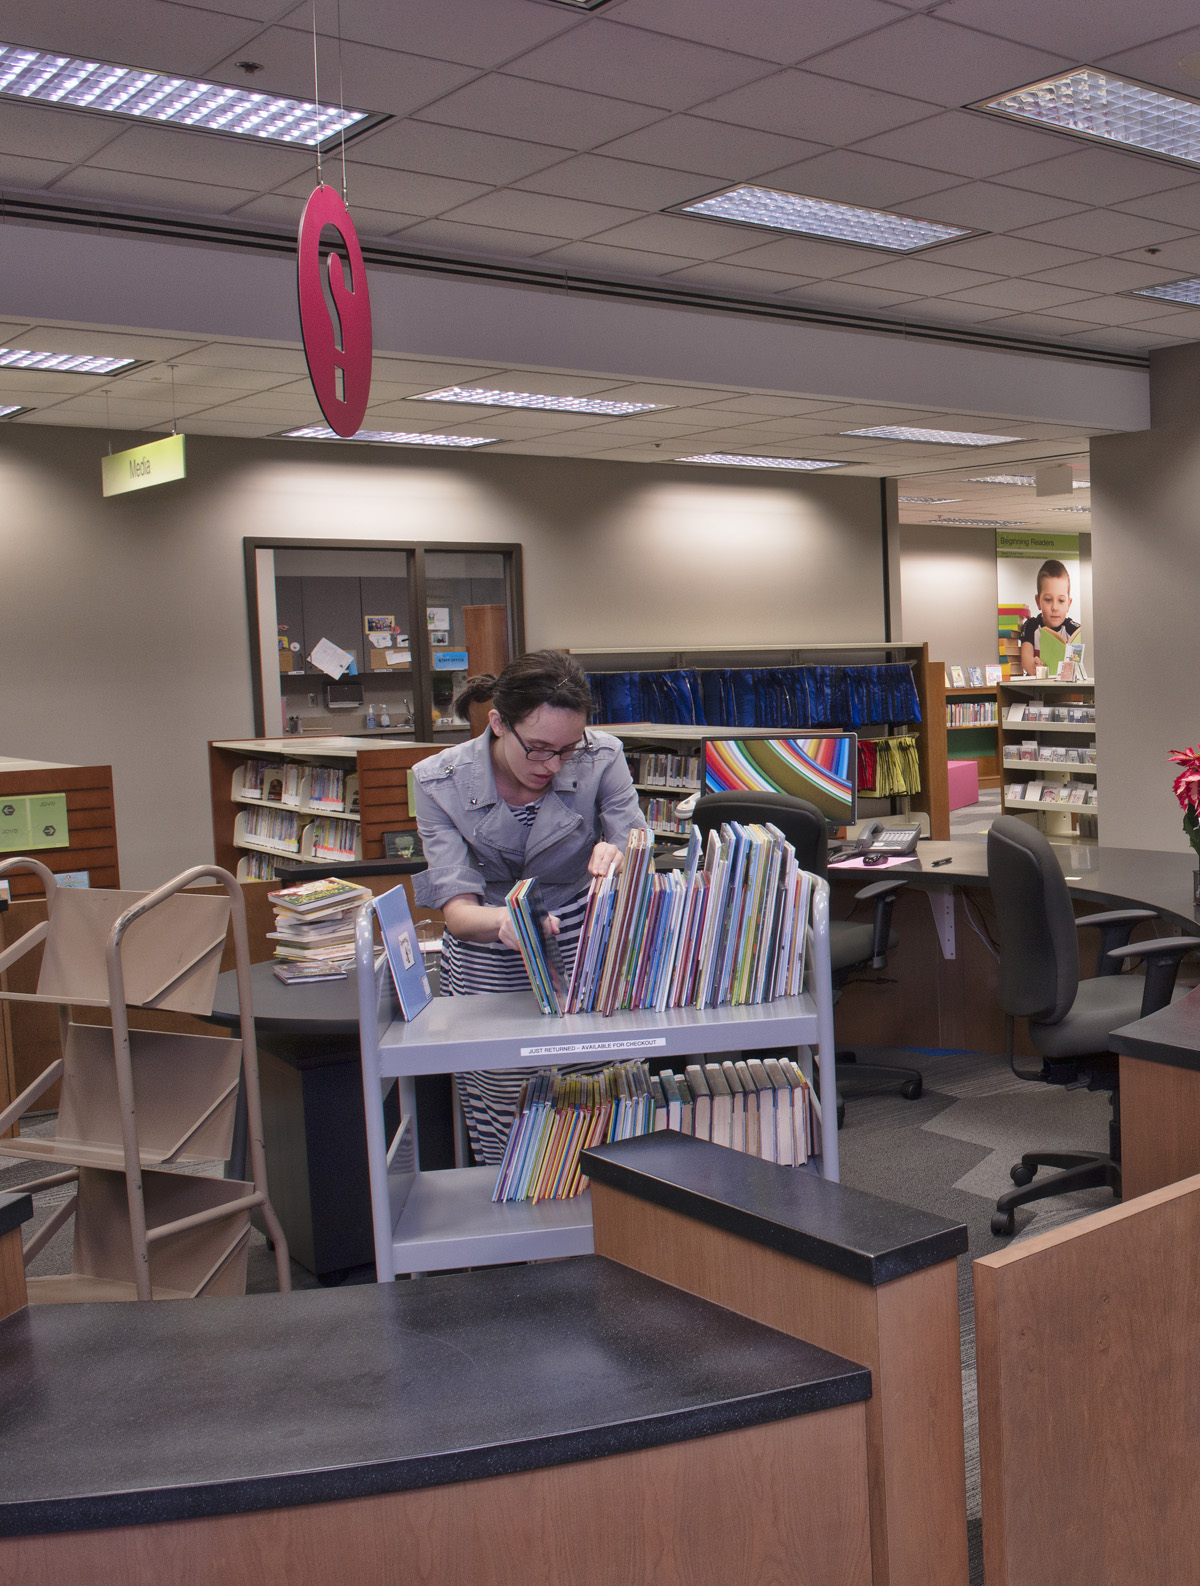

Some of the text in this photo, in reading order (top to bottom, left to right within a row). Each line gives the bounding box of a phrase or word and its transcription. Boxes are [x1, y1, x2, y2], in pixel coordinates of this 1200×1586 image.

[129, 456, 152, 479] Media
[1000, 537, 1055, 547] Beginning Readers
[581, 1043, 612, 1051] AVAILABLE
